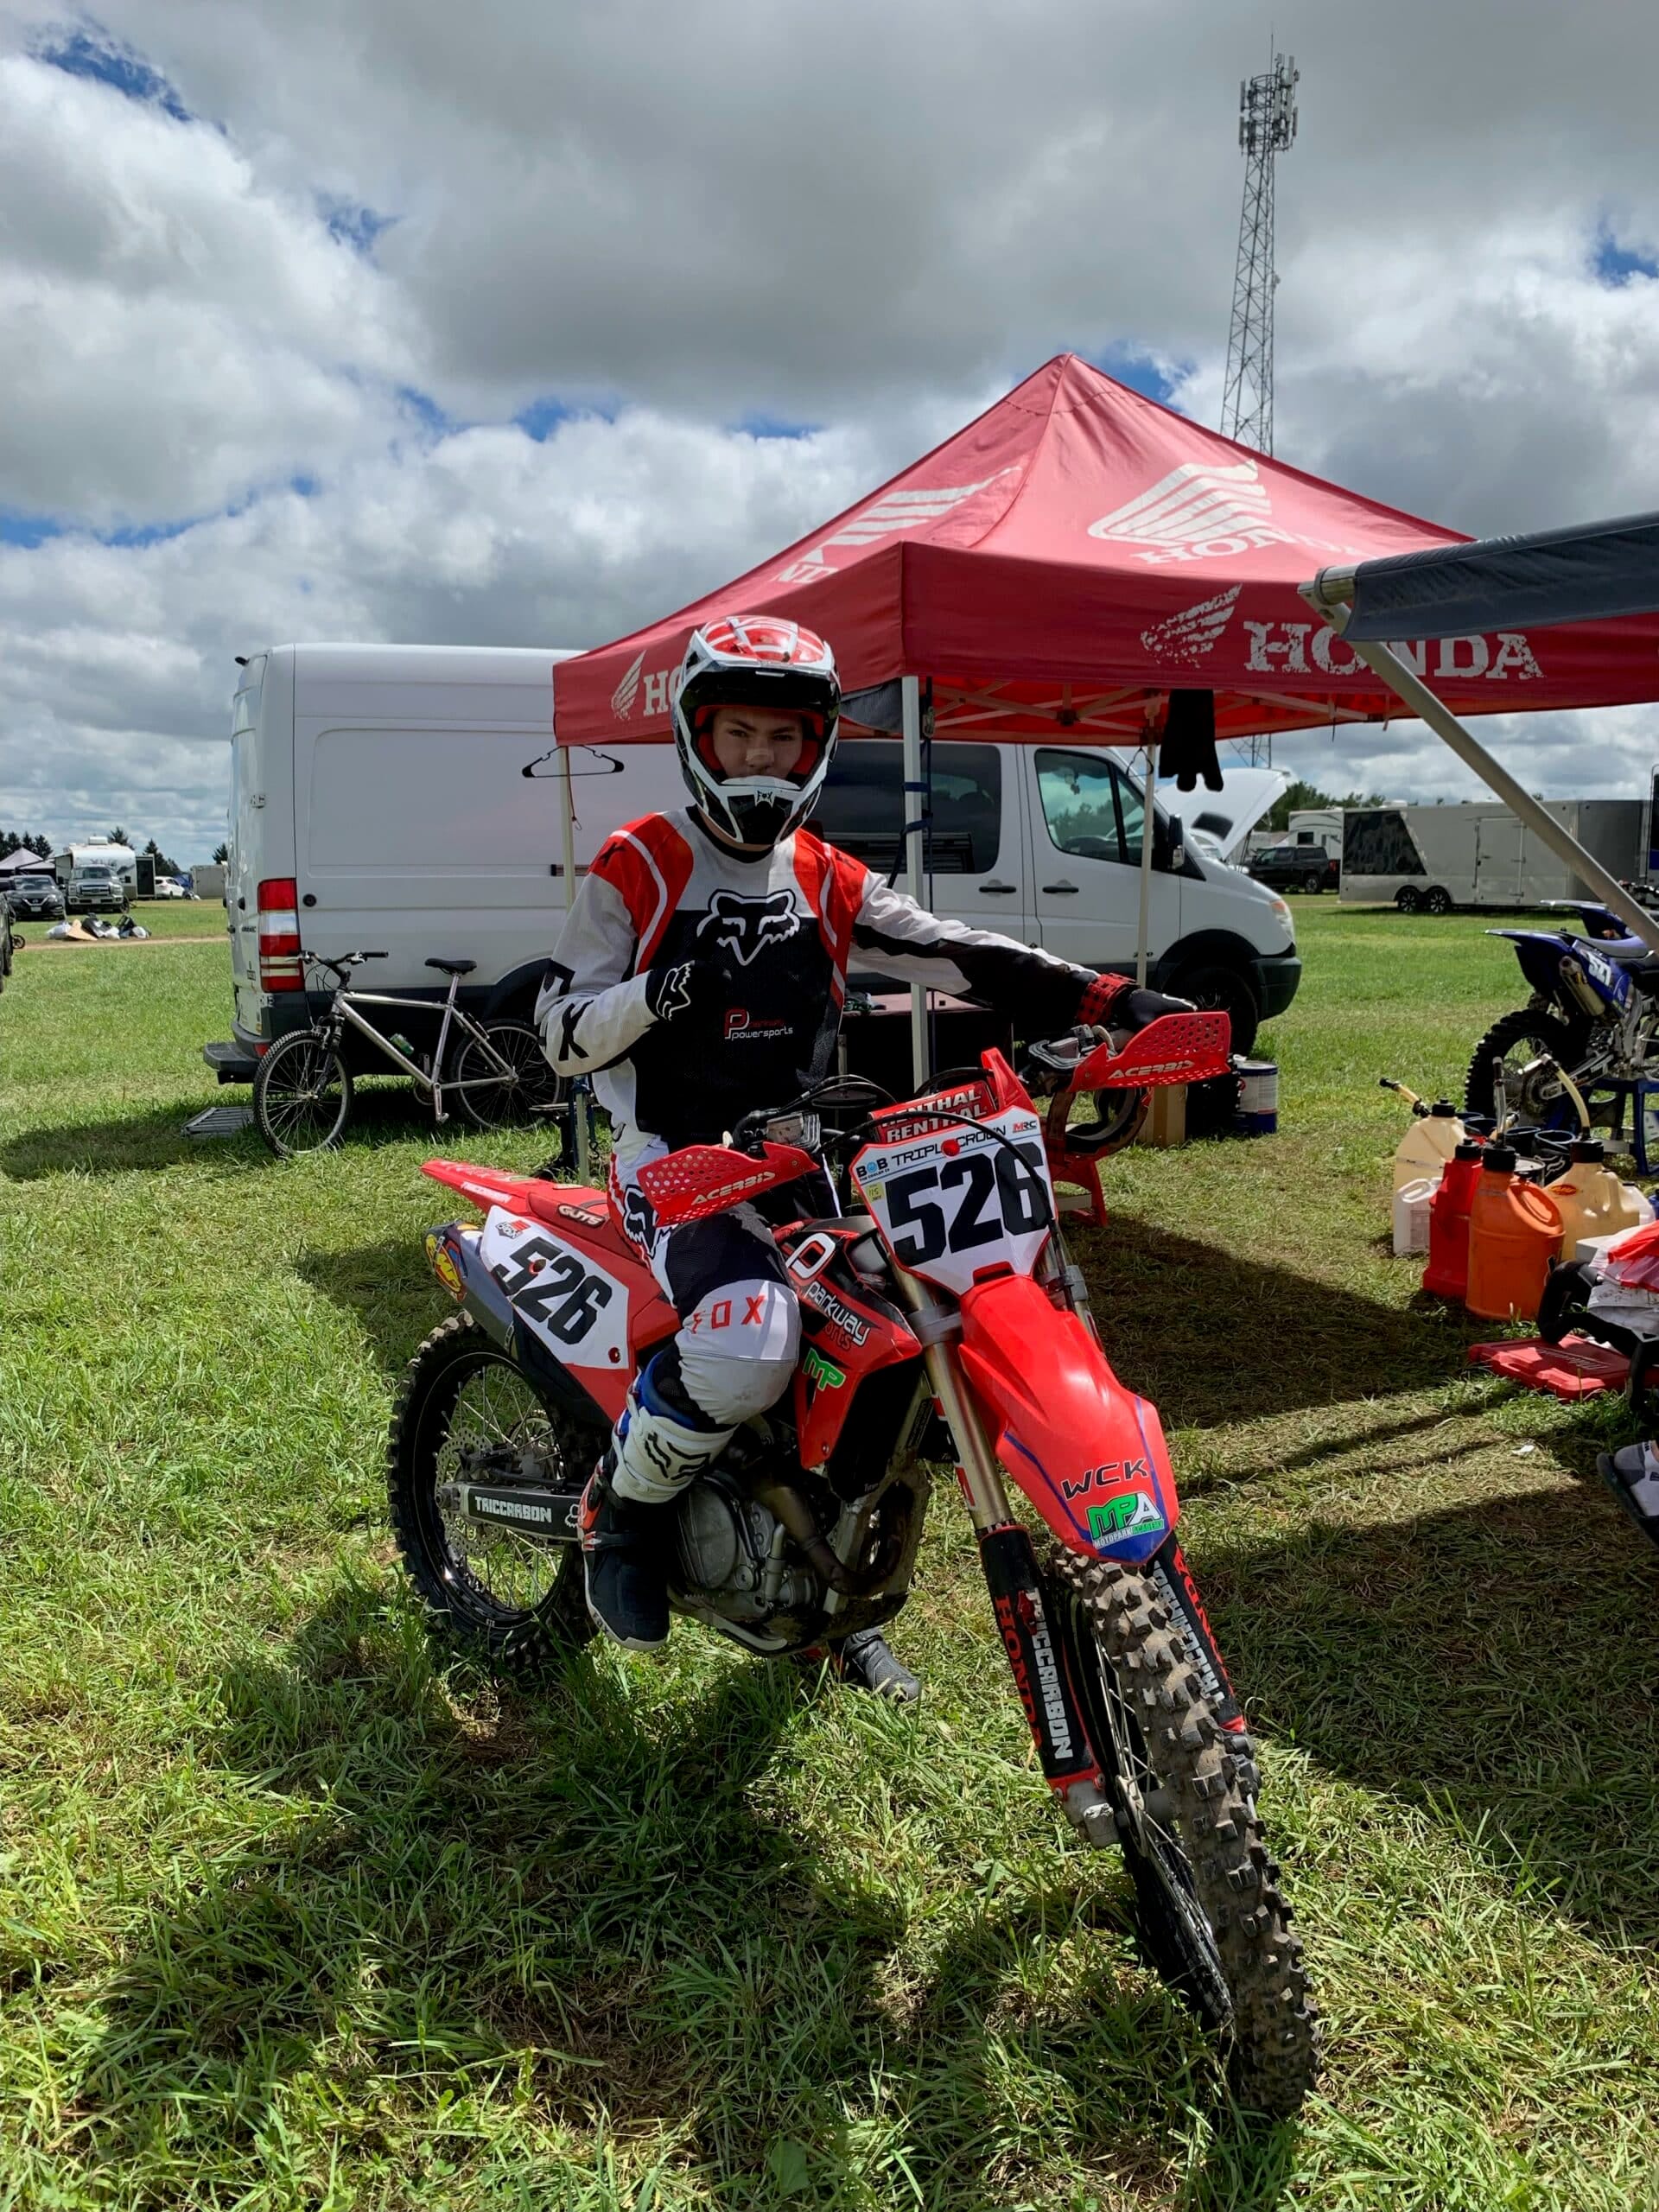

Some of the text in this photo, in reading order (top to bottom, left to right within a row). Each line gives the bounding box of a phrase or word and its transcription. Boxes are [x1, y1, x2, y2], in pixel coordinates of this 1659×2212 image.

[731, 1026, 794, 1041] powersports
[1108, 1059, 1195, 1079] ACERBIS
[891, 1144, 947, 1166] TRIPL
[690, 1171, 776, 1205] ACERBIS
[558, 1204, 606, 1225] GUTS
[885, 1141, 1049, 1266] 526
[490, 1236, 613, 1345] 526
[805, 1281, 871, 1346] parkway
[1061, 1459, 1148, 1500] WCK
[1094, 1528, 1133, 1548] MOTOPARK
